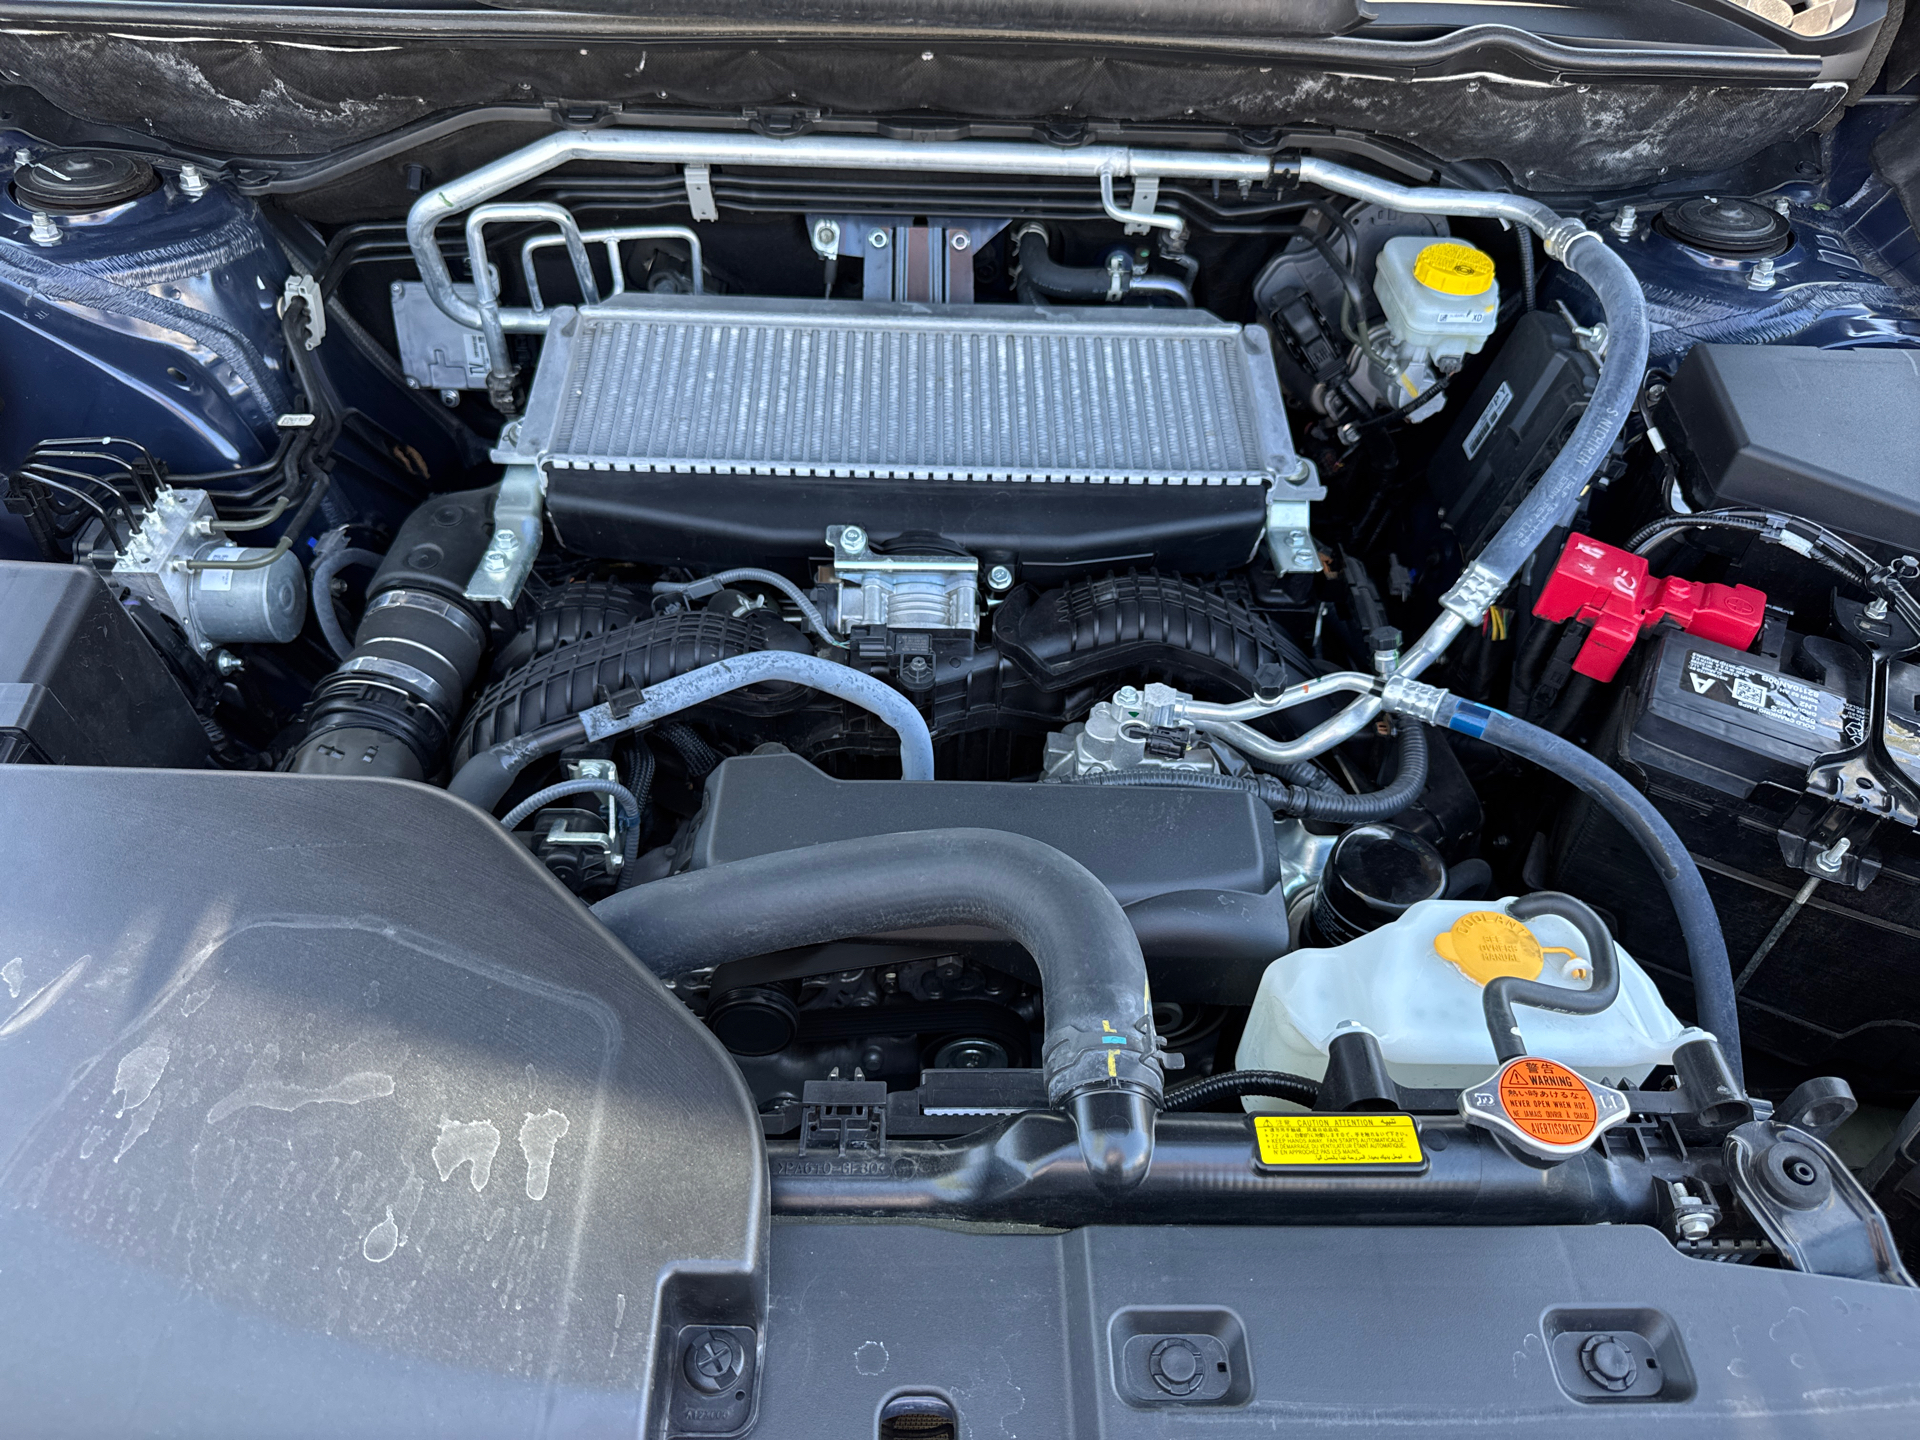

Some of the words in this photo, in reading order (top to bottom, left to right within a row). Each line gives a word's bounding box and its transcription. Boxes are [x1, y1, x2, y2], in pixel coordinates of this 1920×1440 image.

[1574, 416, 1614, 468] NICHIRIN
[1737, 701, 1757, 710] AMPS
[1769, 704, 1798, 718] AMPS
[1798, 700, 1818, 711] LN2
[1758, 708, 1795, 723] CRANKING
[1795, 719, 1815, 729] COLD
[1456, 913, 1528, 935] COOLANT
[1481, 953, 1521, 962] MANUAL
[1525, 1062, 1554, 1075] 警告
[1528, 1075, 1573, 1088] WARNING
[1534, 1100, 1550, 1108] OPEN
[1574, 1102, 1589, 1110] HOT.
[1296, 1119, 1330, 1127] CAUTION
[1334, 1118, 1374, 1126] ATTENTION
